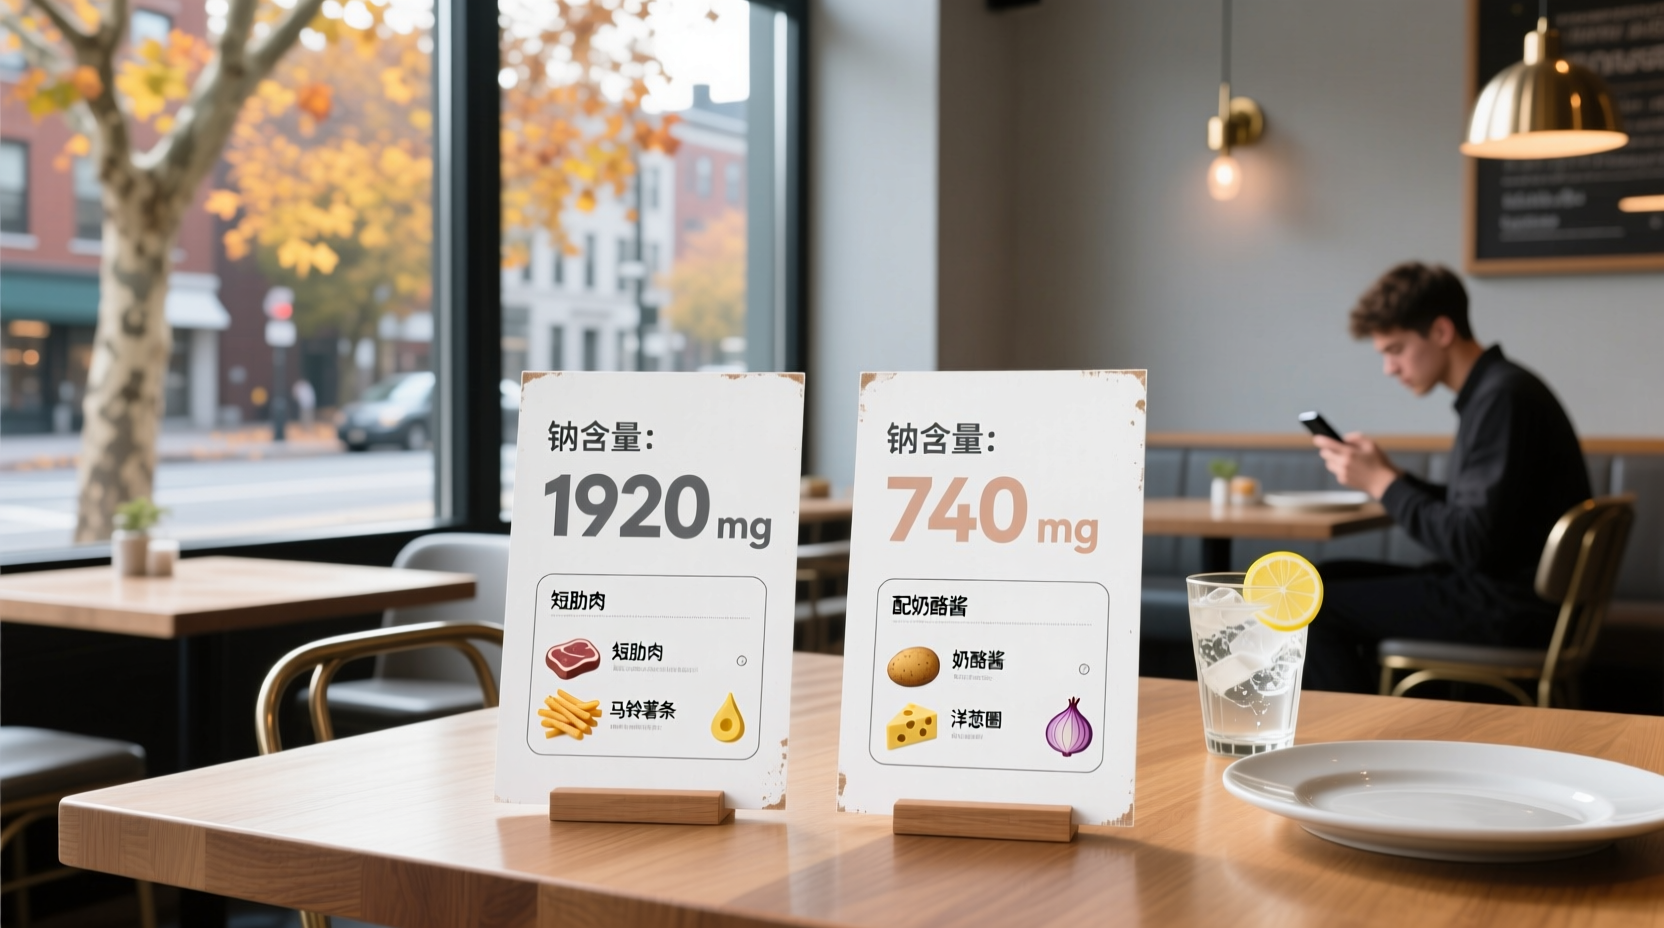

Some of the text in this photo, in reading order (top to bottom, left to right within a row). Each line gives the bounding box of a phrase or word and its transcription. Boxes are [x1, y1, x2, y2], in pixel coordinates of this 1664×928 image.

[548, 420, 654, 452] 钠含量：
[887, 421, 996, 455] 钠含量：
[545, 473, 772, 550] 1920 mg
[887, 476, 1099, 554] 740 mg
[550, 589, 606, 611] 短肋肉
[892, 594, 968, 617] 配奶酪酱
[952, 649, 1005, 670] 奶酪酱
[610, 700, 676, 720] 马铃薯条
